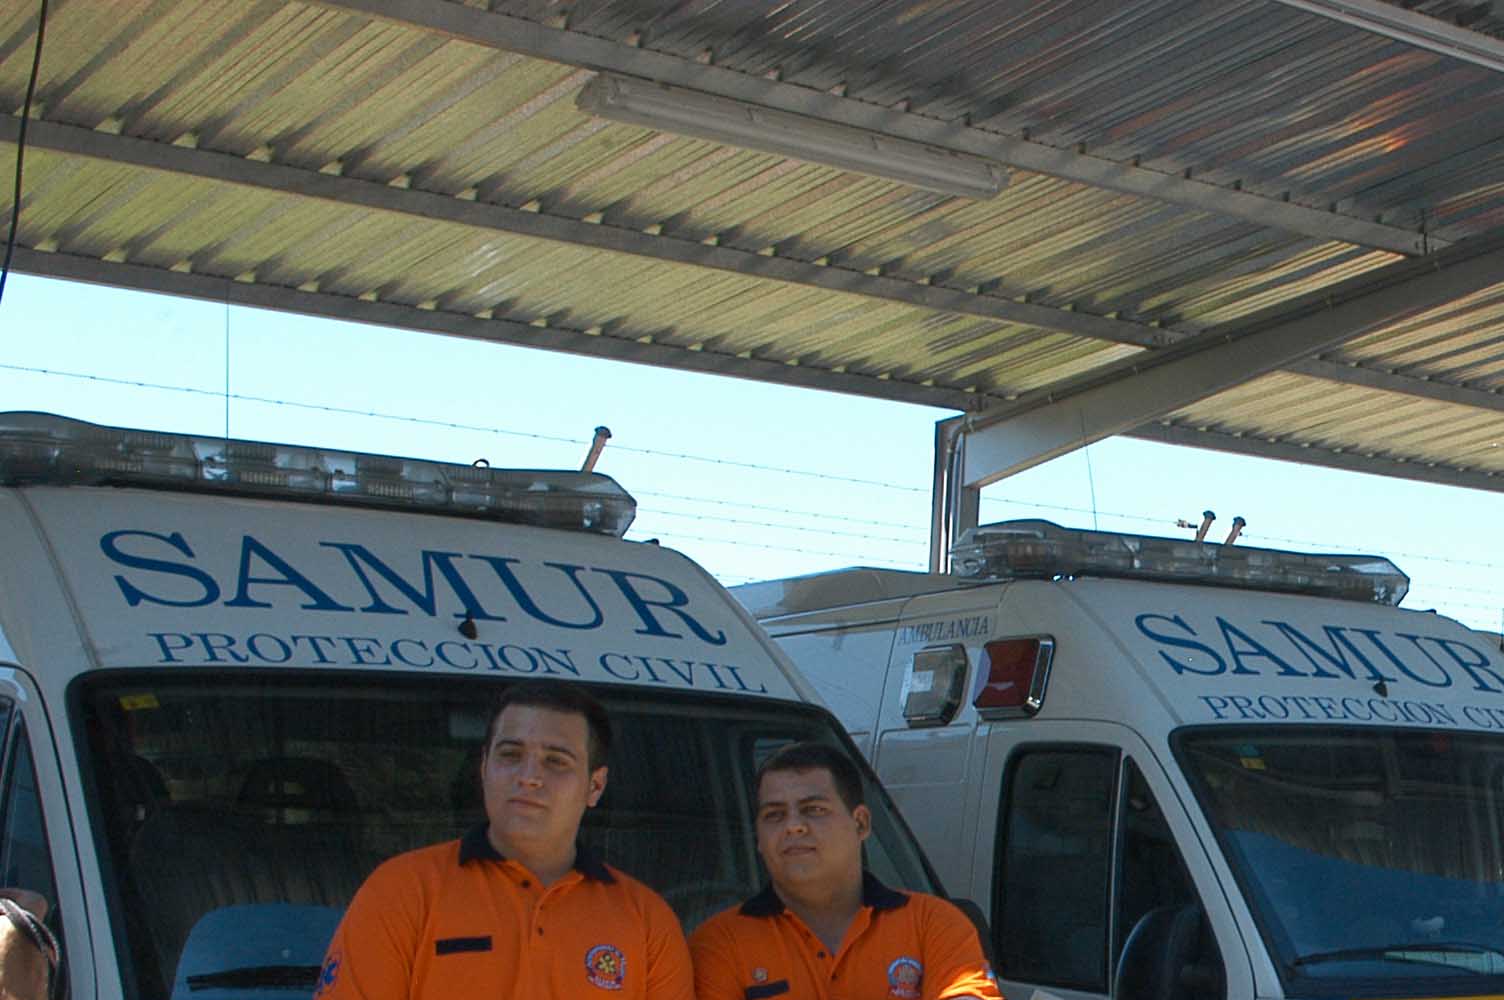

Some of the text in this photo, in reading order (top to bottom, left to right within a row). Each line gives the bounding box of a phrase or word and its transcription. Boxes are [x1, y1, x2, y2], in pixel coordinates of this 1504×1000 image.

[100, 530, 727, 646] SAMUR
[898, 615, 989, 645] AMBULANCIA
[147, 633, 768, 694] PROTECCION CIVIL
[1198, 694, 1457, 726] PROTECCION
